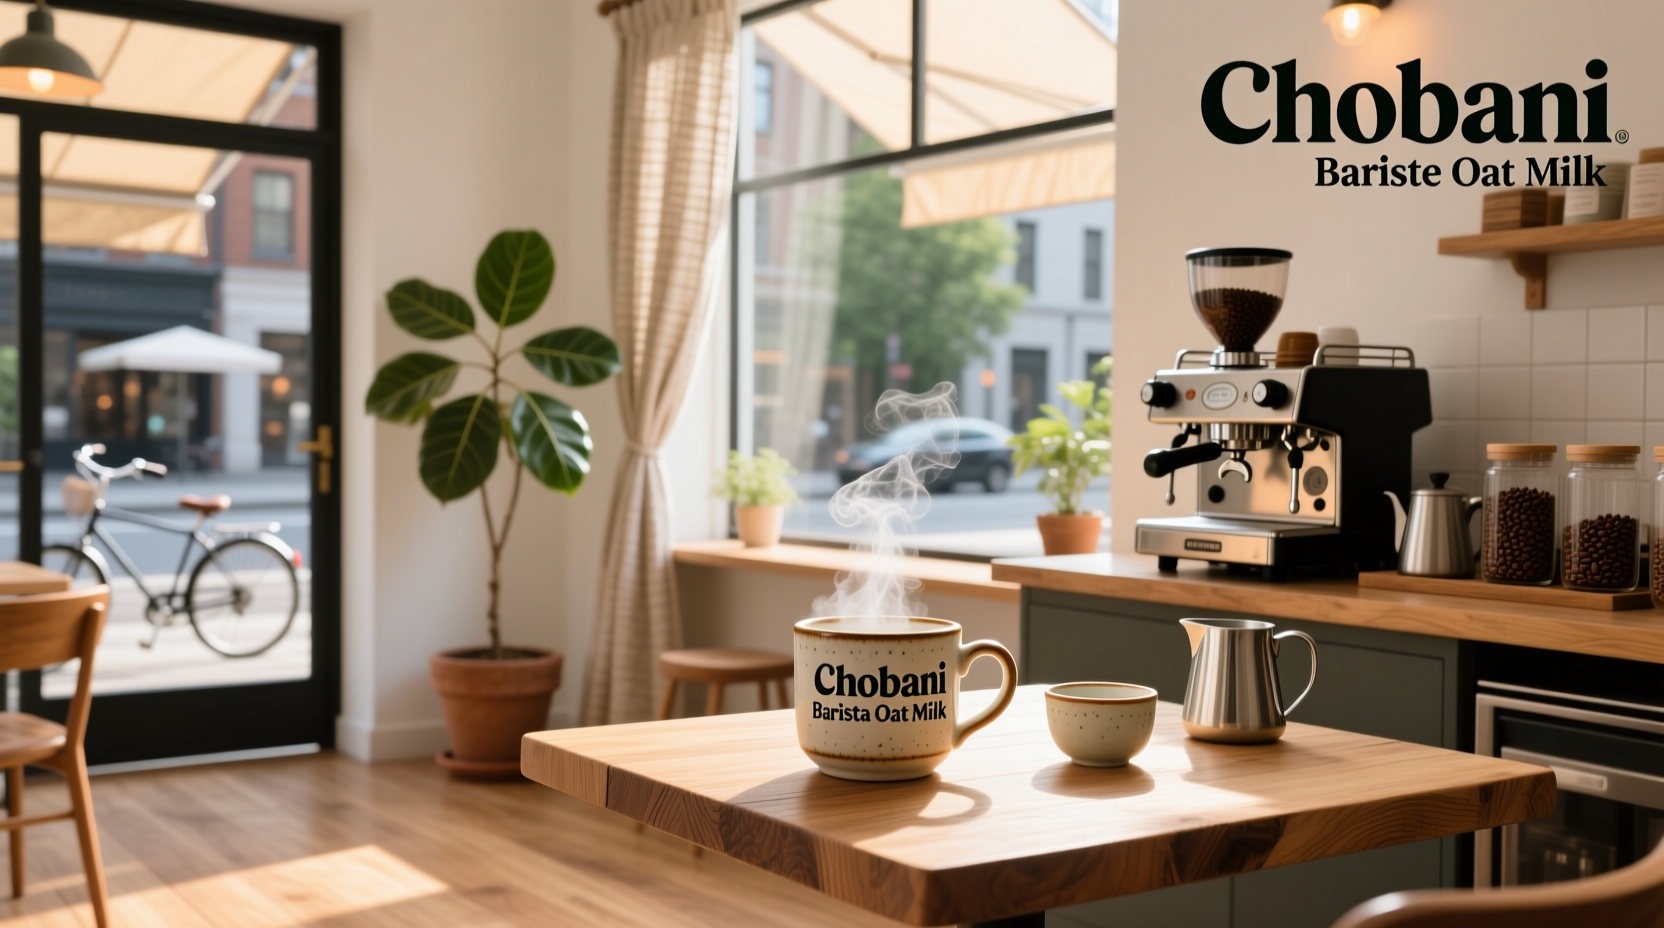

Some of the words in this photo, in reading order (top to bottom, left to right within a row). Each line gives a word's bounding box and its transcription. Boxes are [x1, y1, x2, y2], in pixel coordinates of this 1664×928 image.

[814, 661, 947, 698] Chobani
[812, 701, 871, 722] Barista
[875, 704, 909, 722] Oat
[912, 700, 947, 722] Milk
